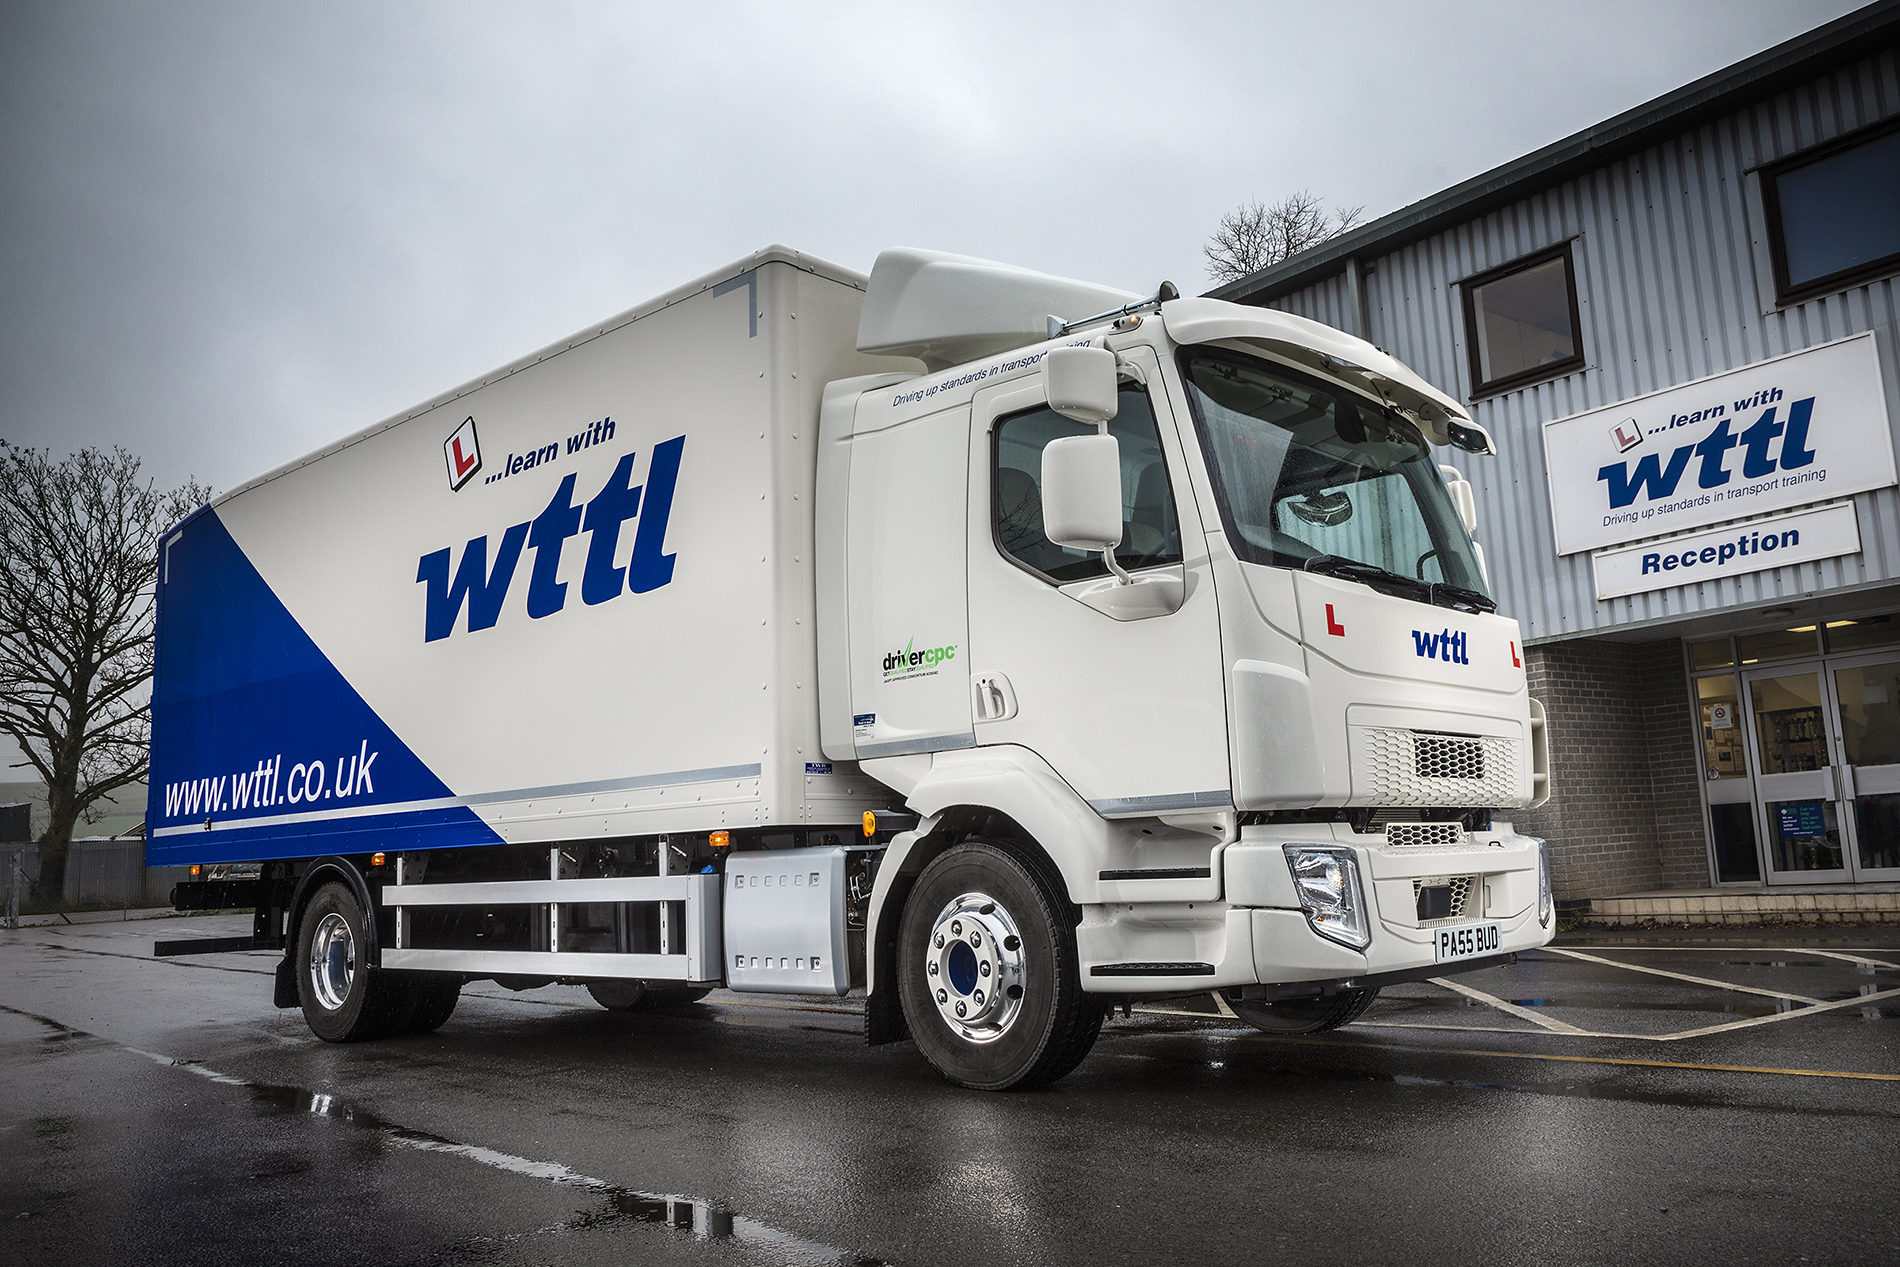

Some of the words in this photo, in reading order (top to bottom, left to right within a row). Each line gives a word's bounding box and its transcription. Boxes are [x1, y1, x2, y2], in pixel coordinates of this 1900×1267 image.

[893, 389, 924, 407] Driving
[926, 384, 938, 398] up
[940, 369, 987, 392] standards
[989, 365, 998, 377] in
[1615, 426, 1636, 447] L
[1734, 387, 1783, 412] with
[451, 435, 475, 479] L
[567, 416, 616, 455] with
[1597, 397, 1816, 509] wttl
[1603, 509, 1639, 527] Driving
[1641, 507, 1655, 520] up
[1657, 494, 1710, 515] standards
[1714, 491, 1724, 503] in
[1727, 478, 1779, 500] transport
[1782, 468, 1827, 490] training
[416, 434, 686, 643] wttl
[1641, 529, 1800, 575] Reception
[1325, 603, 1345, 637] L
[1411, 628, 1469, 665] wttl
[1510, 641, 1521, 668] L
[165, 739, 379, 818] www.wttl.co.uk
[1441, 929, 1474, 958] PA55
[1476, 925, 1498, 952] BUD
